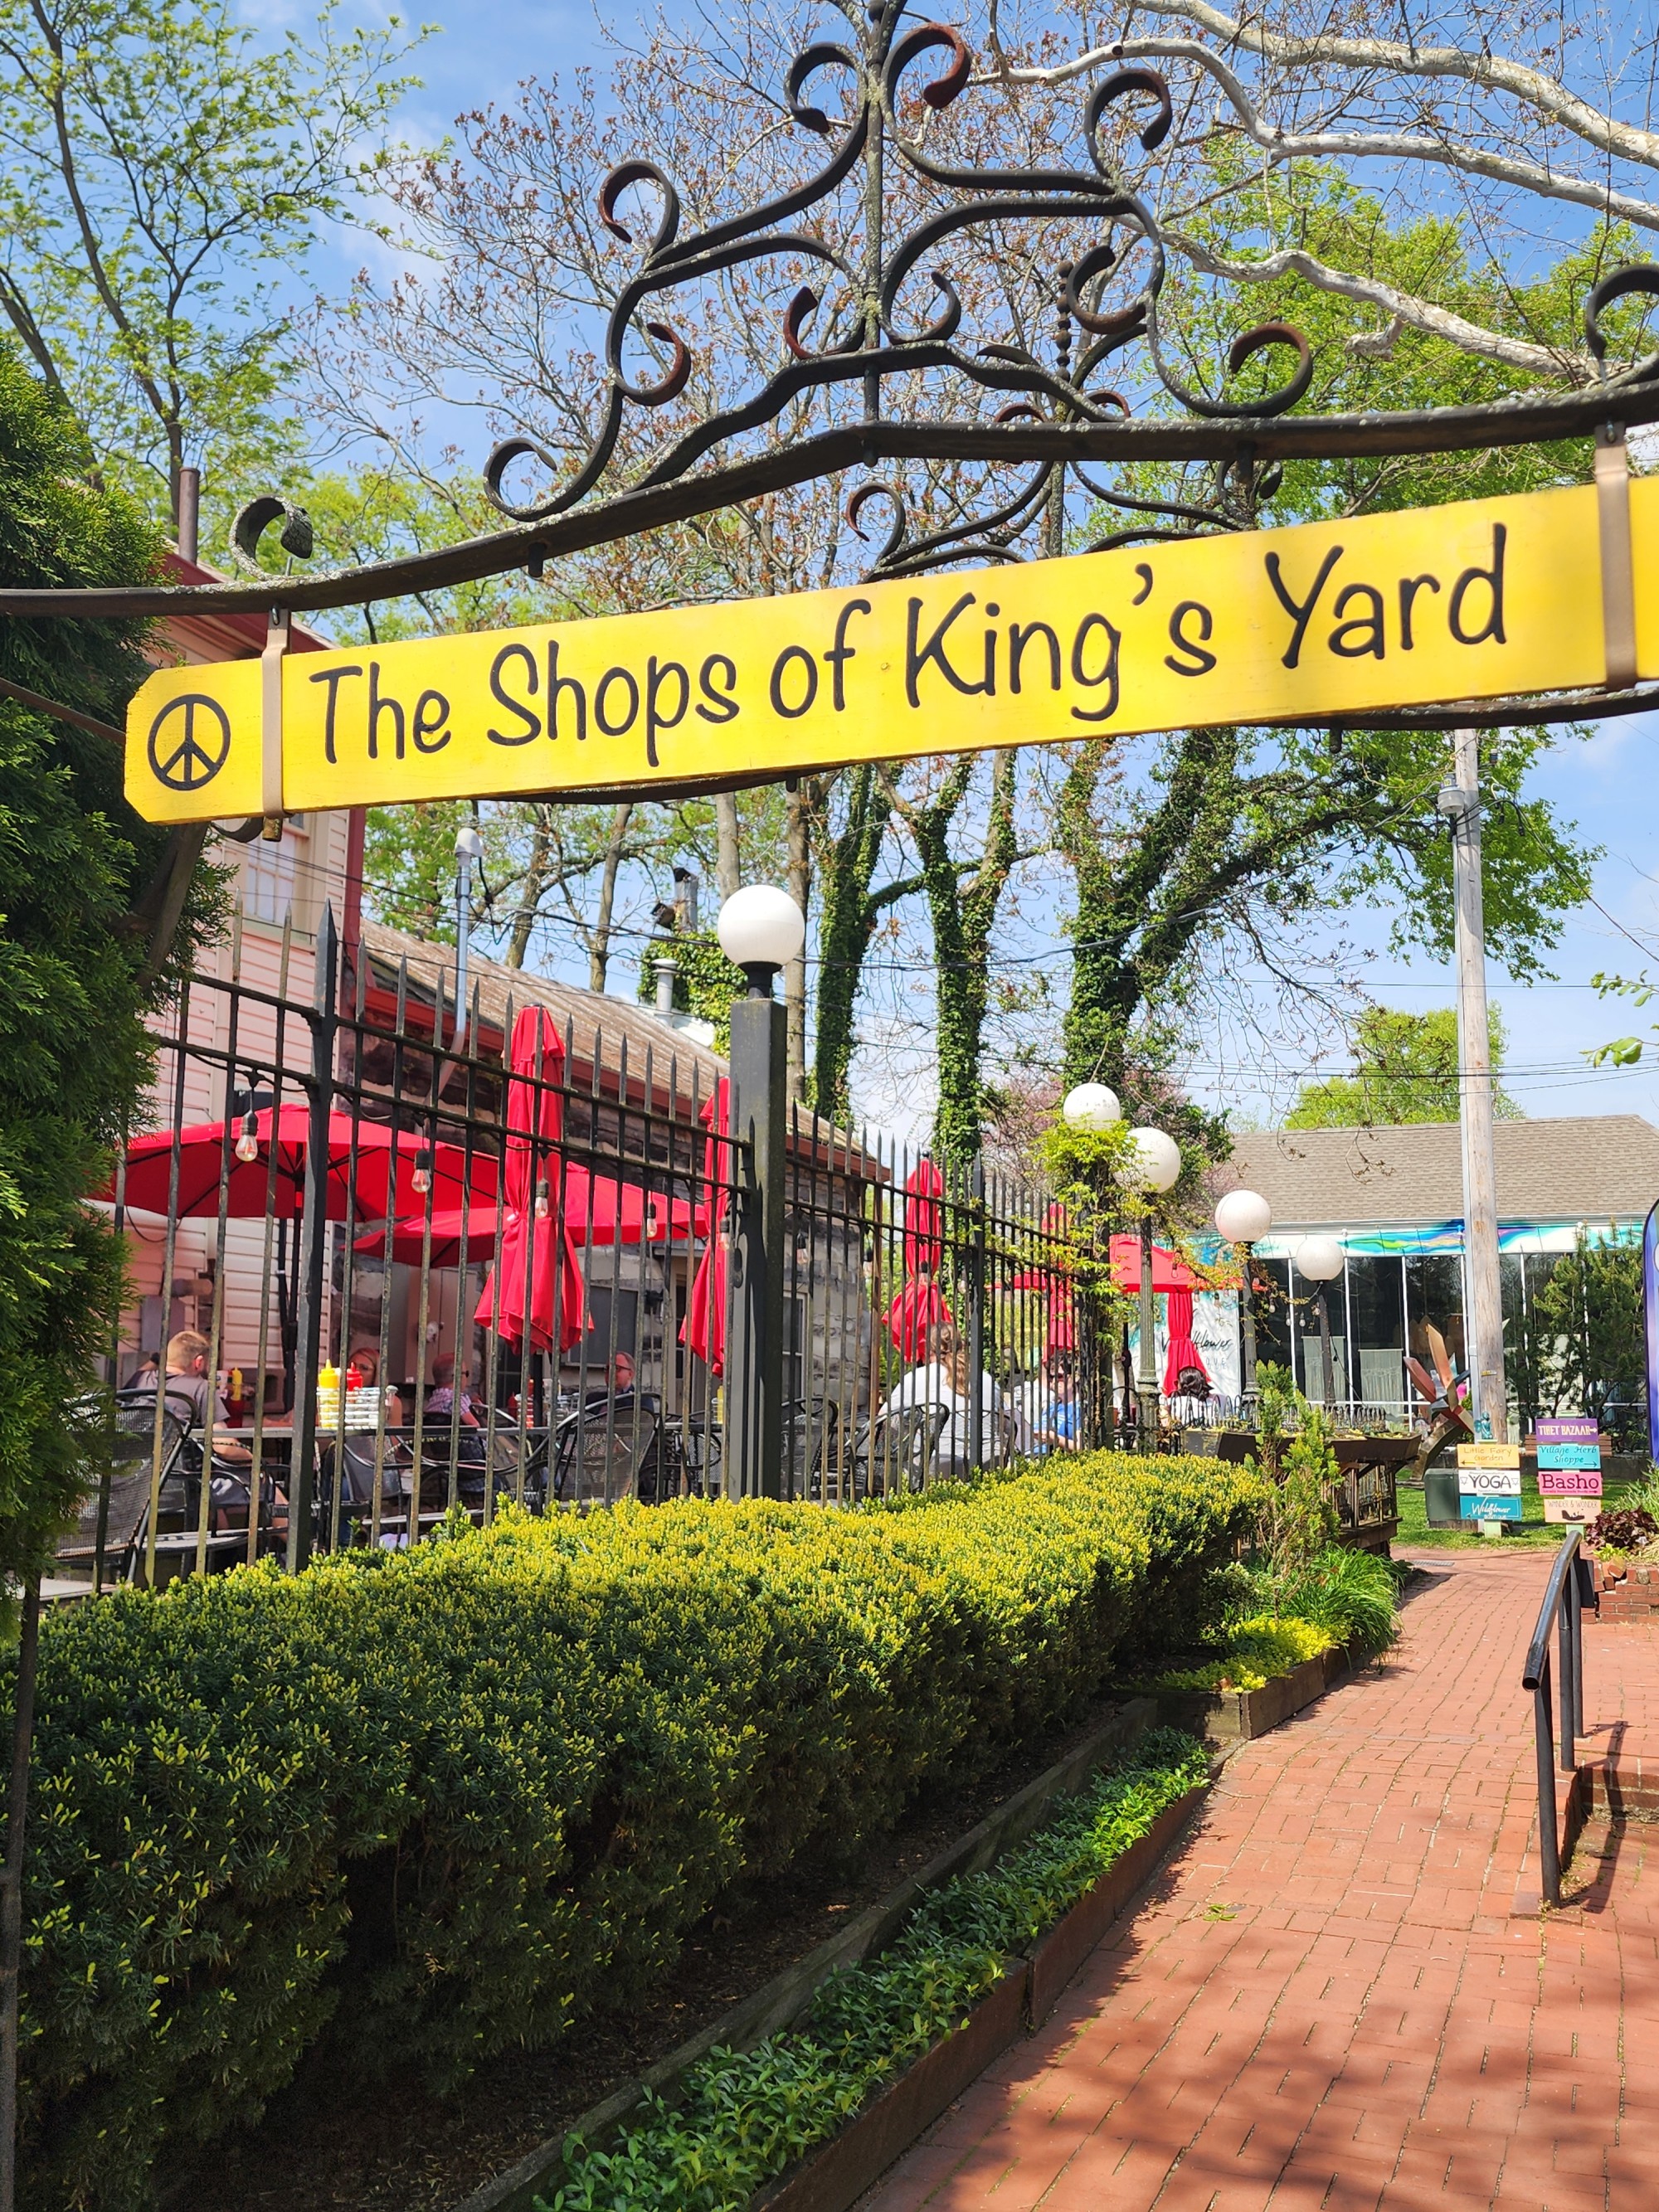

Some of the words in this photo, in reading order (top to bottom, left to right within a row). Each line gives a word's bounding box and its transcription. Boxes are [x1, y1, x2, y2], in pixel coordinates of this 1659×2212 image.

[309, 663, 451, 764] The
[487, 641, 740, 767] Shops
[770, 599, 872, 718] of
[906, 564, 1217, 722] King's
[1265, 523, 1506, 669] Yard
[1538, 1425, 1559, 1436] TIBET
[1561, 1425, 1591, 1436] BAZAAR
[1539, 1446, 1569, 1457] Village
[1574, 1446, 1597, 1454] Herb
[1554, 1455, 1584, 1466] Shoppe
[1468, 1474, 1512, 1489] YOGA
[1541, 1474, 1599, 1490] Basho
